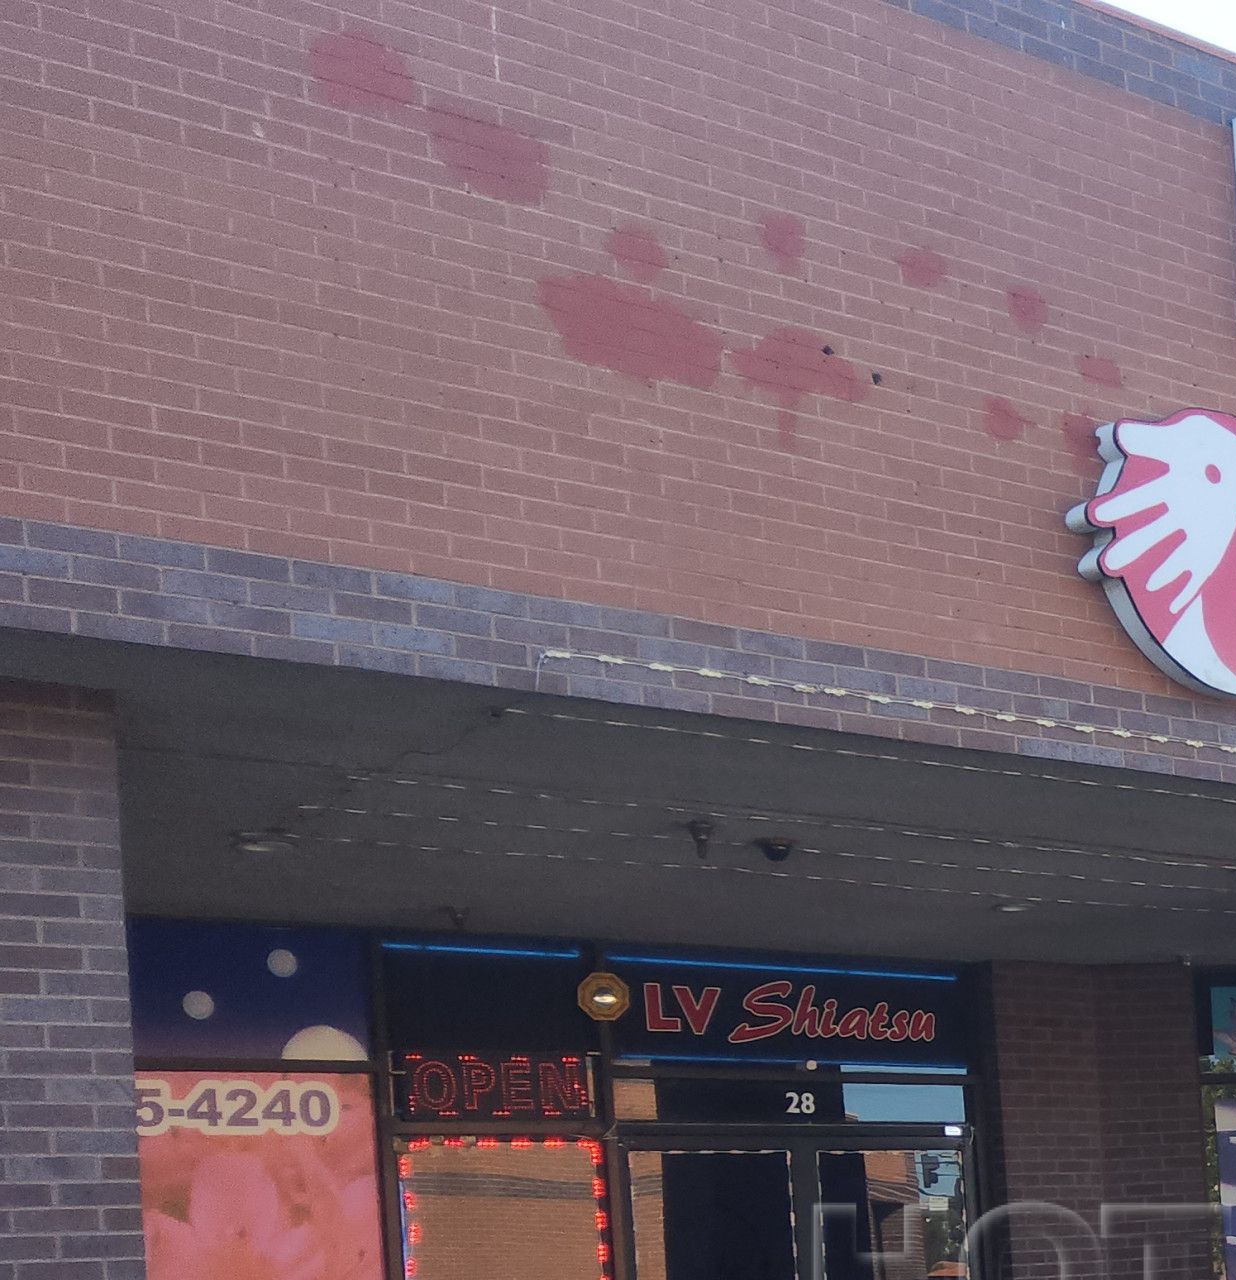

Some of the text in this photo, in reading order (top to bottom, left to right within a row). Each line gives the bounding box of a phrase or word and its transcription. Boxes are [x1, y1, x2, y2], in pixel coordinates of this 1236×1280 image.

[644, 980, 936, 1043] LV Shiatsu
[412, 1061, 581, 1110] OPEN
[785, 1092, 815, 1114] 28
